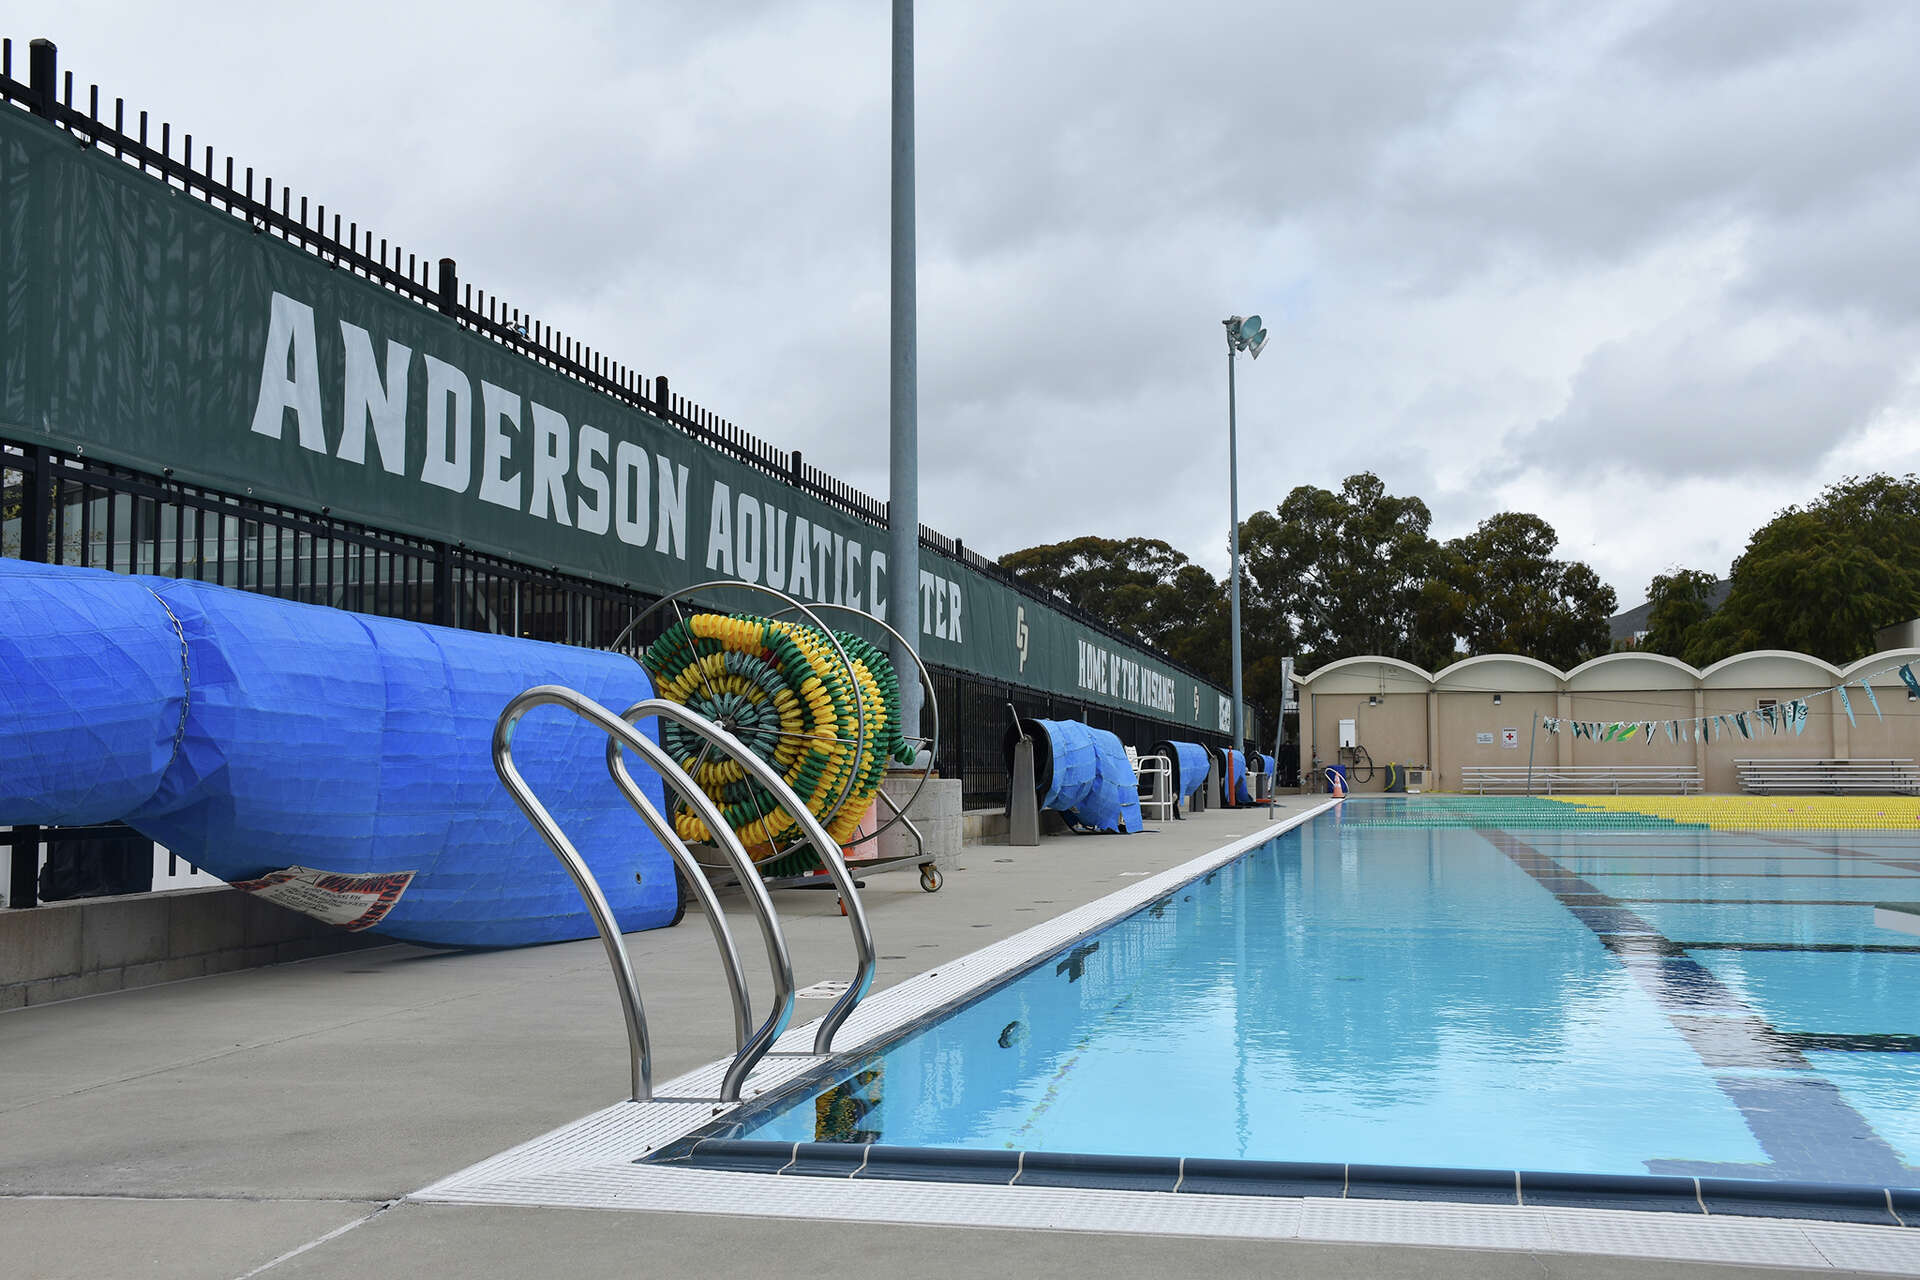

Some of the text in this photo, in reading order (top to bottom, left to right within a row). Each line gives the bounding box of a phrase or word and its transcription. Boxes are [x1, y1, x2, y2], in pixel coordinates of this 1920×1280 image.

[250, 290, 962, 643] ANDERSON AQUATIC CTER
[1078, 639, 1107, 694] HOME
[1110, 653, 1121, 698] OF
[1121, 658, 1139, 703] THE
